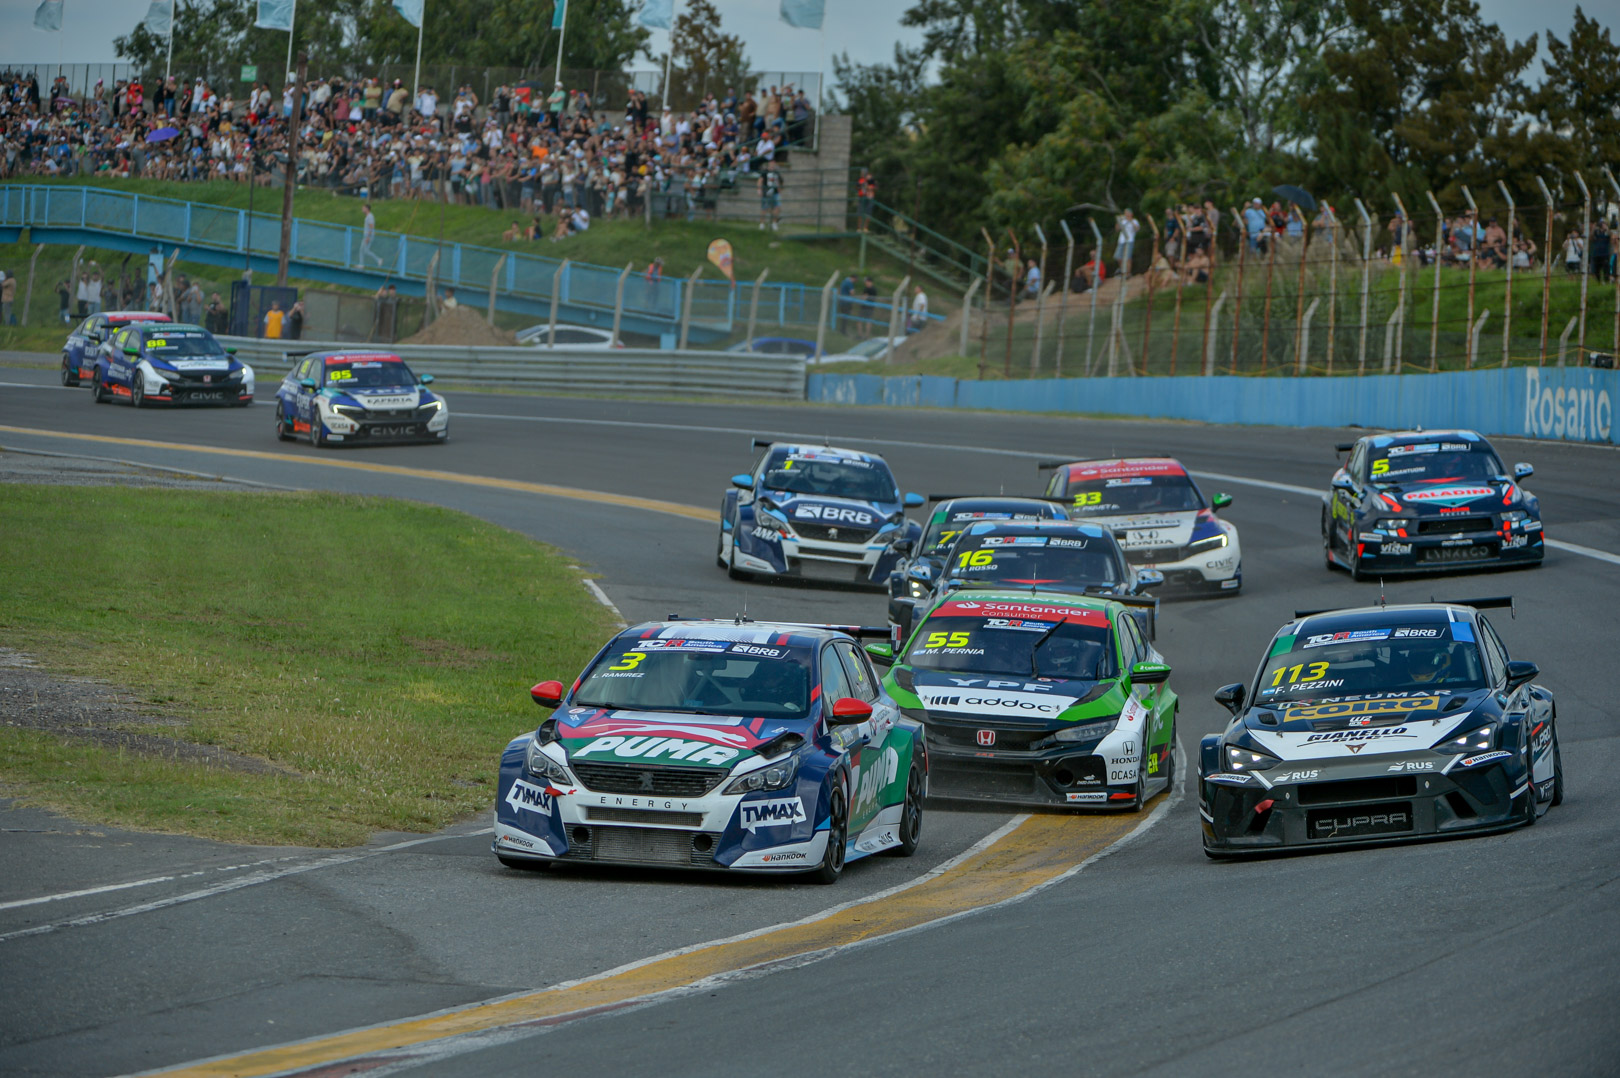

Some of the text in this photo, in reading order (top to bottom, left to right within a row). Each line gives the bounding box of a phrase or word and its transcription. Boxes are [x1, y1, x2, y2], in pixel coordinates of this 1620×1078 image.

[330, 369, 352, 381] 85
[190, 392, 223, 400] CIVIC
[1524, 367, 1612, 439] Rosario
[370, 426, 416, 435] CIVIC
[783, 460, 794, 470] 1
[1099, 465, 1169, 474] Santander
[1371, 458, 1390, 474] 5
[1072, 491, 1102, 507] 33
[1406, 488, 1492, 500] PALADINI
[822, 506, 872, 525] BRB
[983, 537, 1017, 545] TCR
[1060, 539, 1082, 547] BRB
[958, 549, 995, 568] 16
[1206, 556, 1233, 569] CIVIC
[968, 564, 999, 572] ROSSO
[981, 609, 1043, 619] Consumer
[983, 602, 1091, 617] Santander
[987, 618, 1023, 627] TCR
[925, 631, 971, 648] 55
[1307, 631, 1352, 645] TCR
[1409, 629, 1438, 637] BRB
[637, 639, 686, 649] TCR
[747, 646, 780, 657] BRB
[608, 652, 647, 671] 3
[1271, 661, 1331, 687] 113
[950, 678, 1053, 691] YPF
[1274, 679, 1345, 695] F. PEZZINI
[1321, 690, 1452, 704] NEUMAR
[965, 697, 1052, 712] addoc
[1288, 698, 1435, 718] COIRO
[1306, 727, 1408, 742] GIANELLO
[572, 736, 740, 766] PUMA
[1406, 762, 1434, 770] RUS
[856, 745, 899, 815] PUMA
[1111, 770, 1138, 781] OCASA
[1291, 770, 1319, 780] RUS
[512, 784, 551, 811] TVMAX
[599, 796, 688, 811] ENERGY
[742, 801, 803, 823] TVMAX
[1315, 812, 1407, 830] CUPRA
